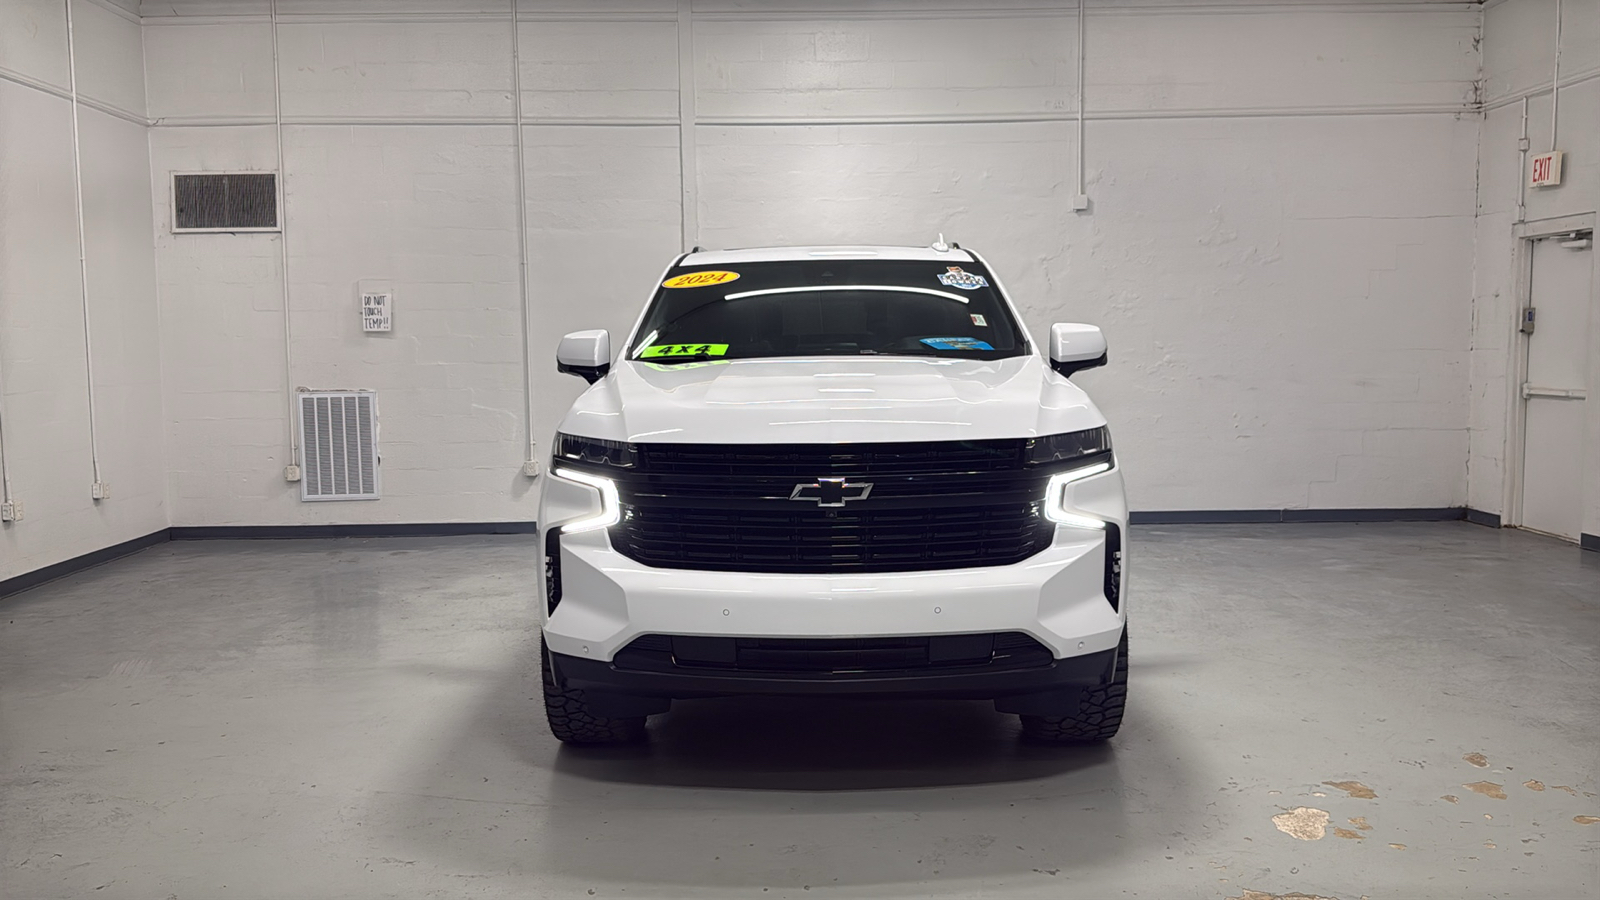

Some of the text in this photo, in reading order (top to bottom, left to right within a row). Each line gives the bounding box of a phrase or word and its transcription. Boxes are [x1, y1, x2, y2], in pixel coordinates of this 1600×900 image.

[1532, 156, 1552, 182] EXIT
[673, 272, 729, 287] 2024
[364, 295, 387, 306] DO NOT
[363, 307, 383, 317] TOUCH
